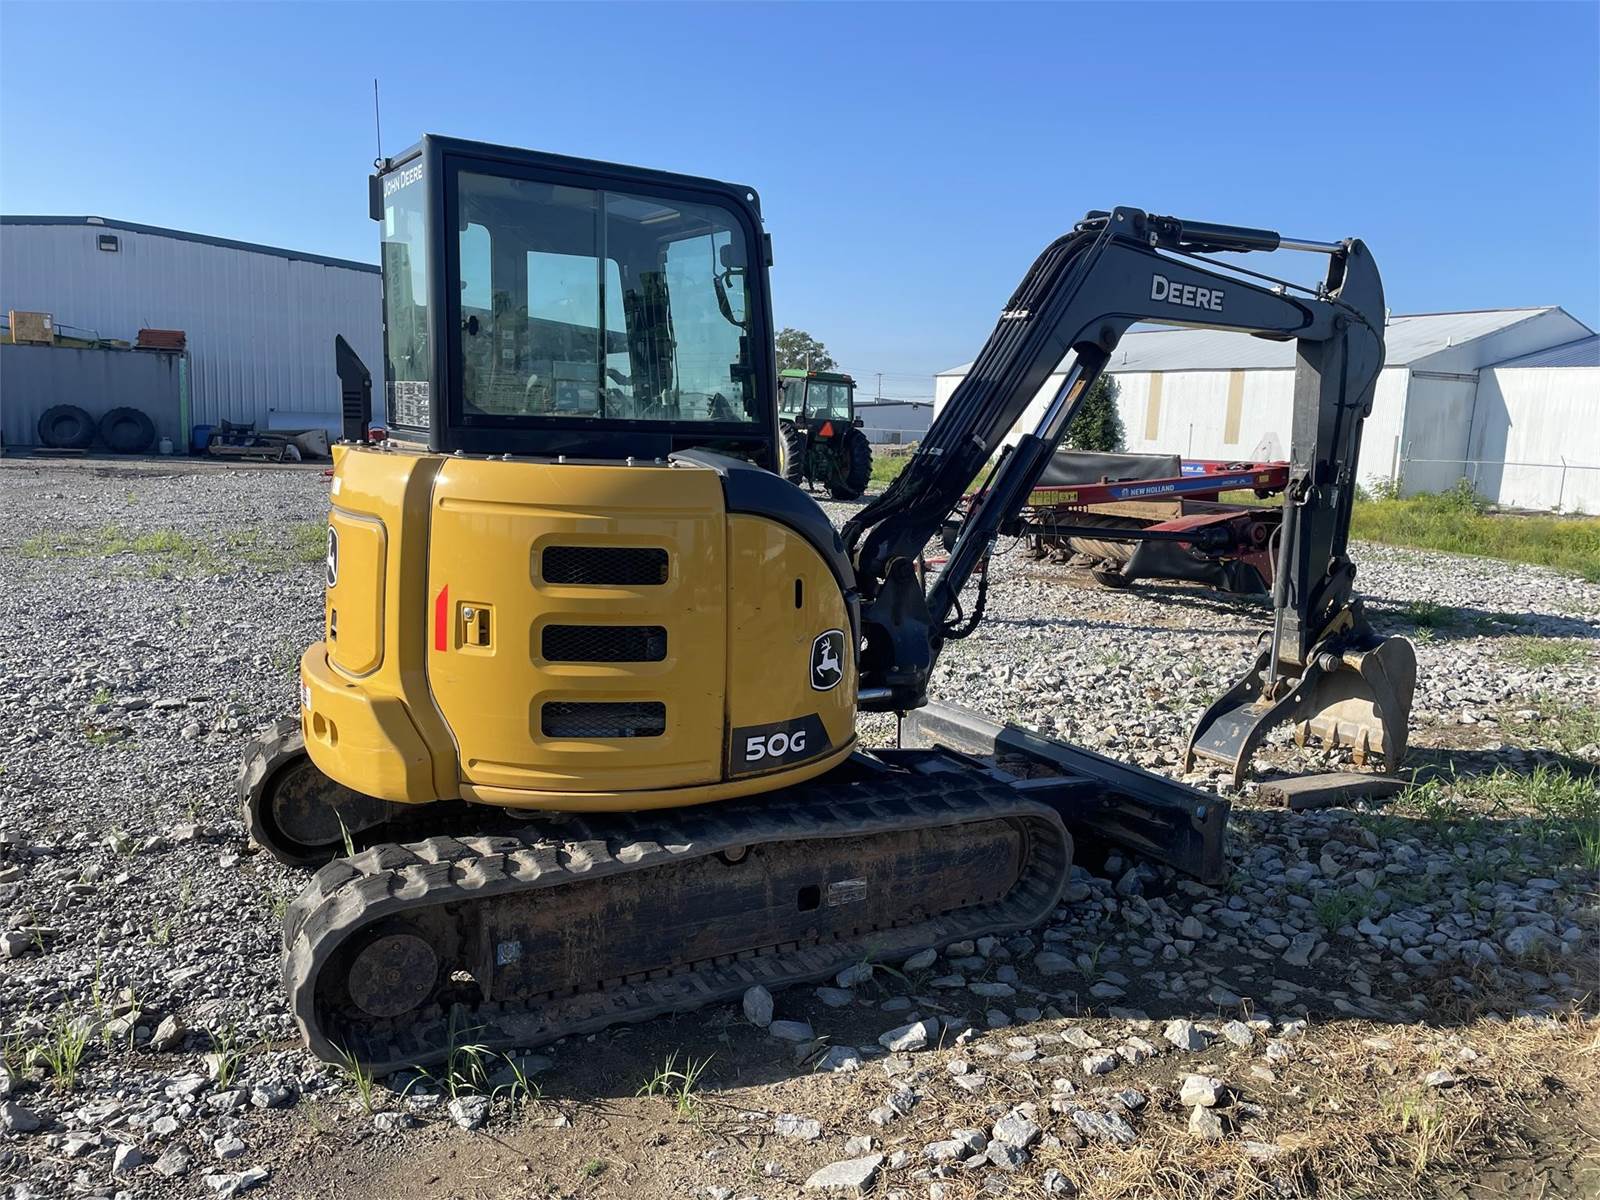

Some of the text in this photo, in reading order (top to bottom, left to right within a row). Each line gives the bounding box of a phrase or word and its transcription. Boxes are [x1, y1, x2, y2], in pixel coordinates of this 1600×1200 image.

[384, 163, 423, 198] JOHN DEERE
[1151, 274, 1224, 311] DEERE
[1130, 484, 1175, 496] NEW HOLLAND
[745, 730, 806, 761] 50G
